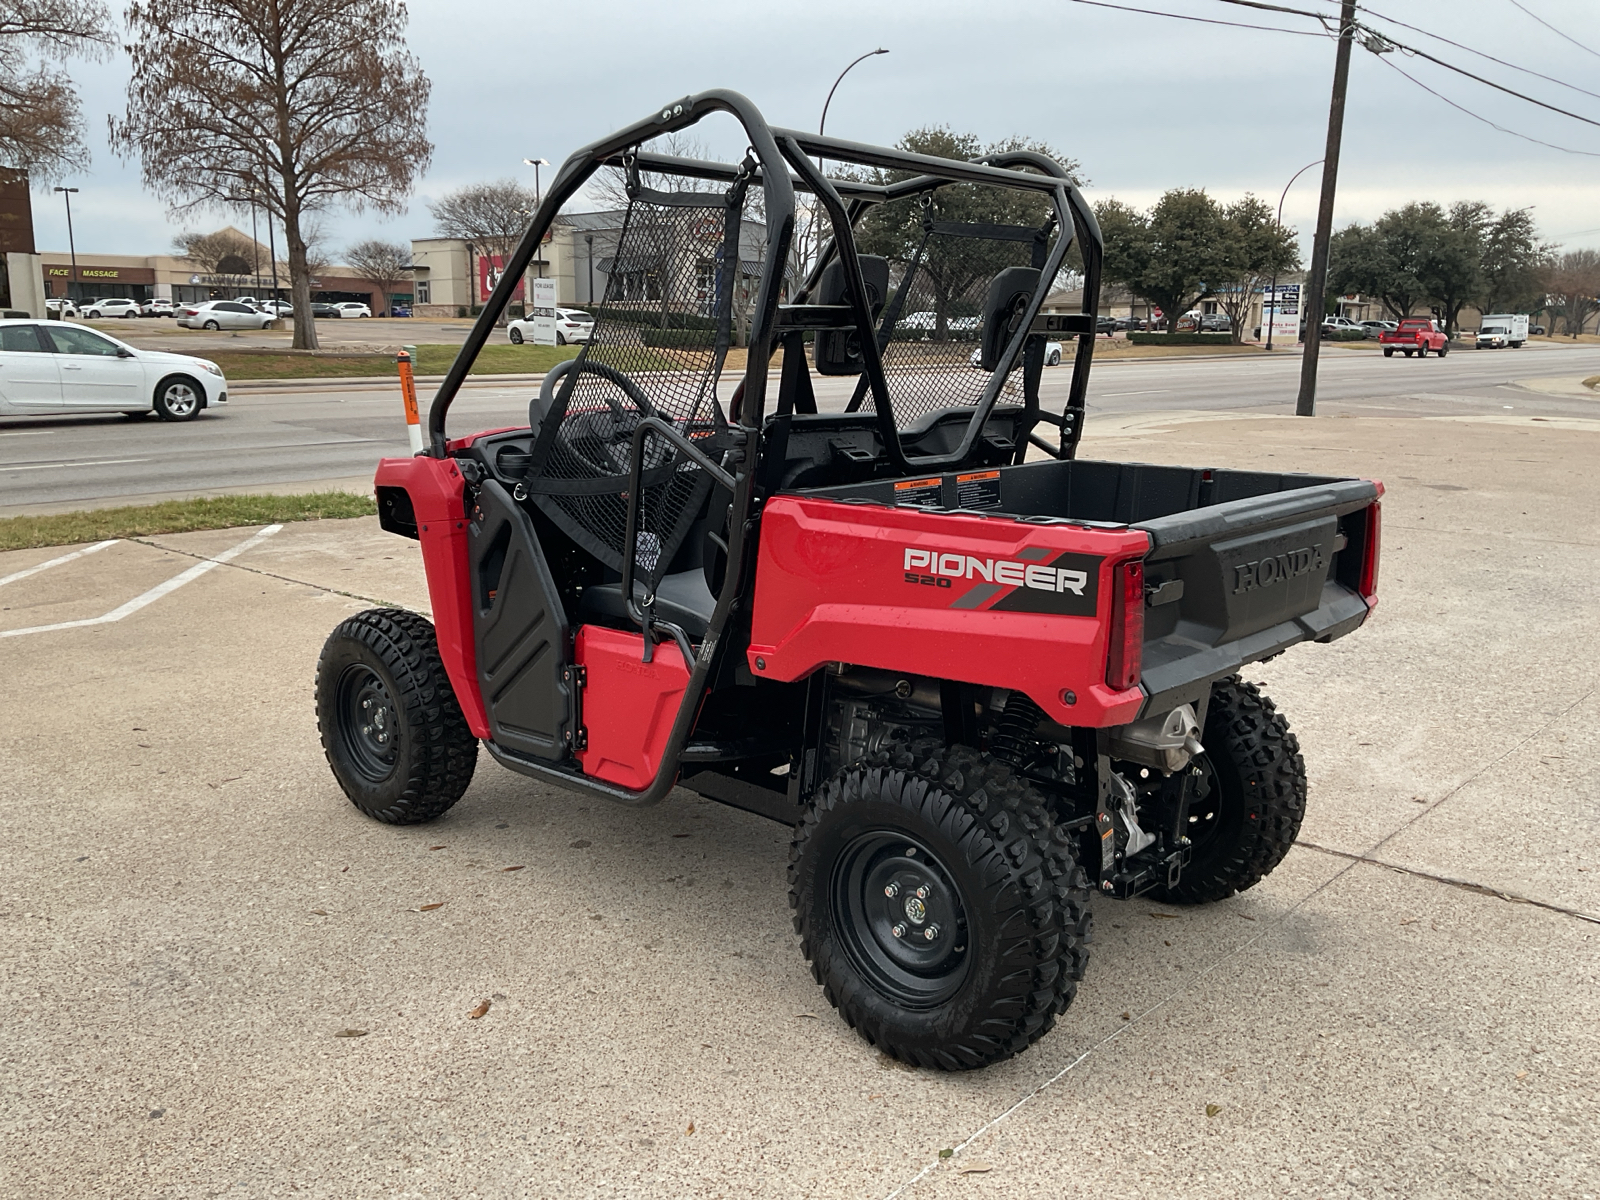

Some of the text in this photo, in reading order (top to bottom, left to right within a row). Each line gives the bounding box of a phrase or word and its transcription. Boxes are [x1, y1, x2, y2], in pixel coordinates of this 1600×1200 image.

[82, 270, 119, 278] MASSAGE
[904, 548, 1088, 596] PIONEER
[904, 573, 951, 588] 520
[1233, 543, 1327, 595] HONDA
